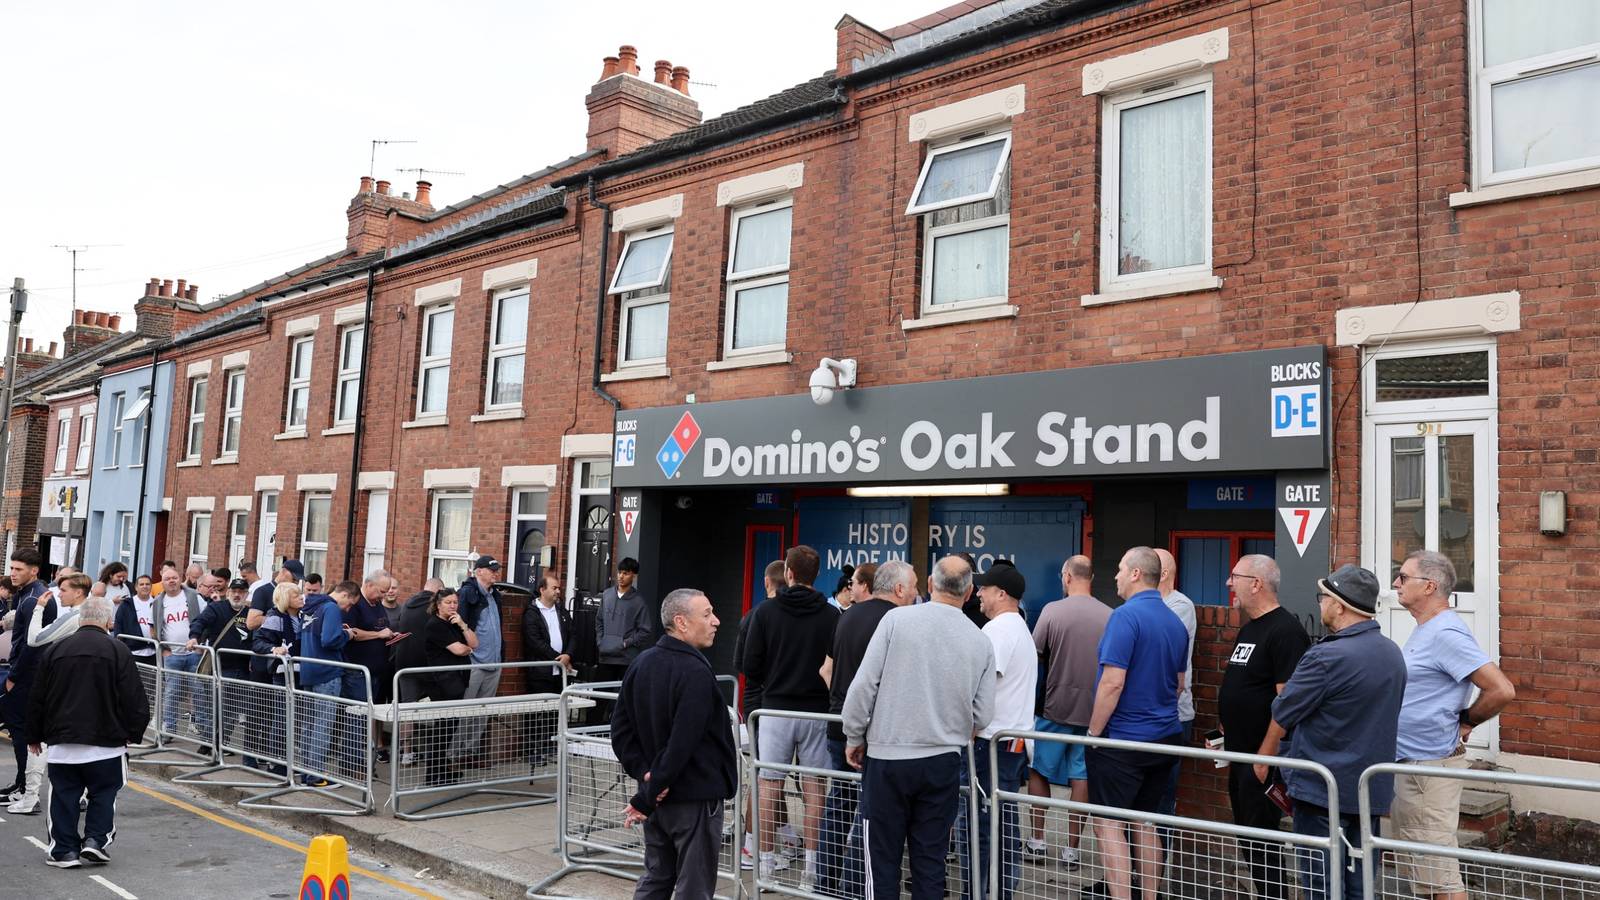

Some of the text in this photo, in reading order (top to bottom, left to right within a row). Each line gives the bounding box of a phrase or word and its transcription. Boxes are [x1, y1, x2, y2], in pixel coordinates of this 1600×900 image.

[1271, 362, 1320, 382] BLOCKS
[1275, 392, 1316, 430] D-E
[616, 420, 637, 432] BLOCKS
[703, 396, 1220, 477] Domino's Oak Stand
[616, 439, 635, 462] F-G
[622, 496, 637, 508] GATE
[757, 493, 773, 504] GATE
[1216, 486, 1244, 501] GATE
[1285, 485, 1320, 502] GATE
[625, 512, 632, 535] 6
[1294, 510, 1310, 545] 7
[965, 525, 985, 548] IS
